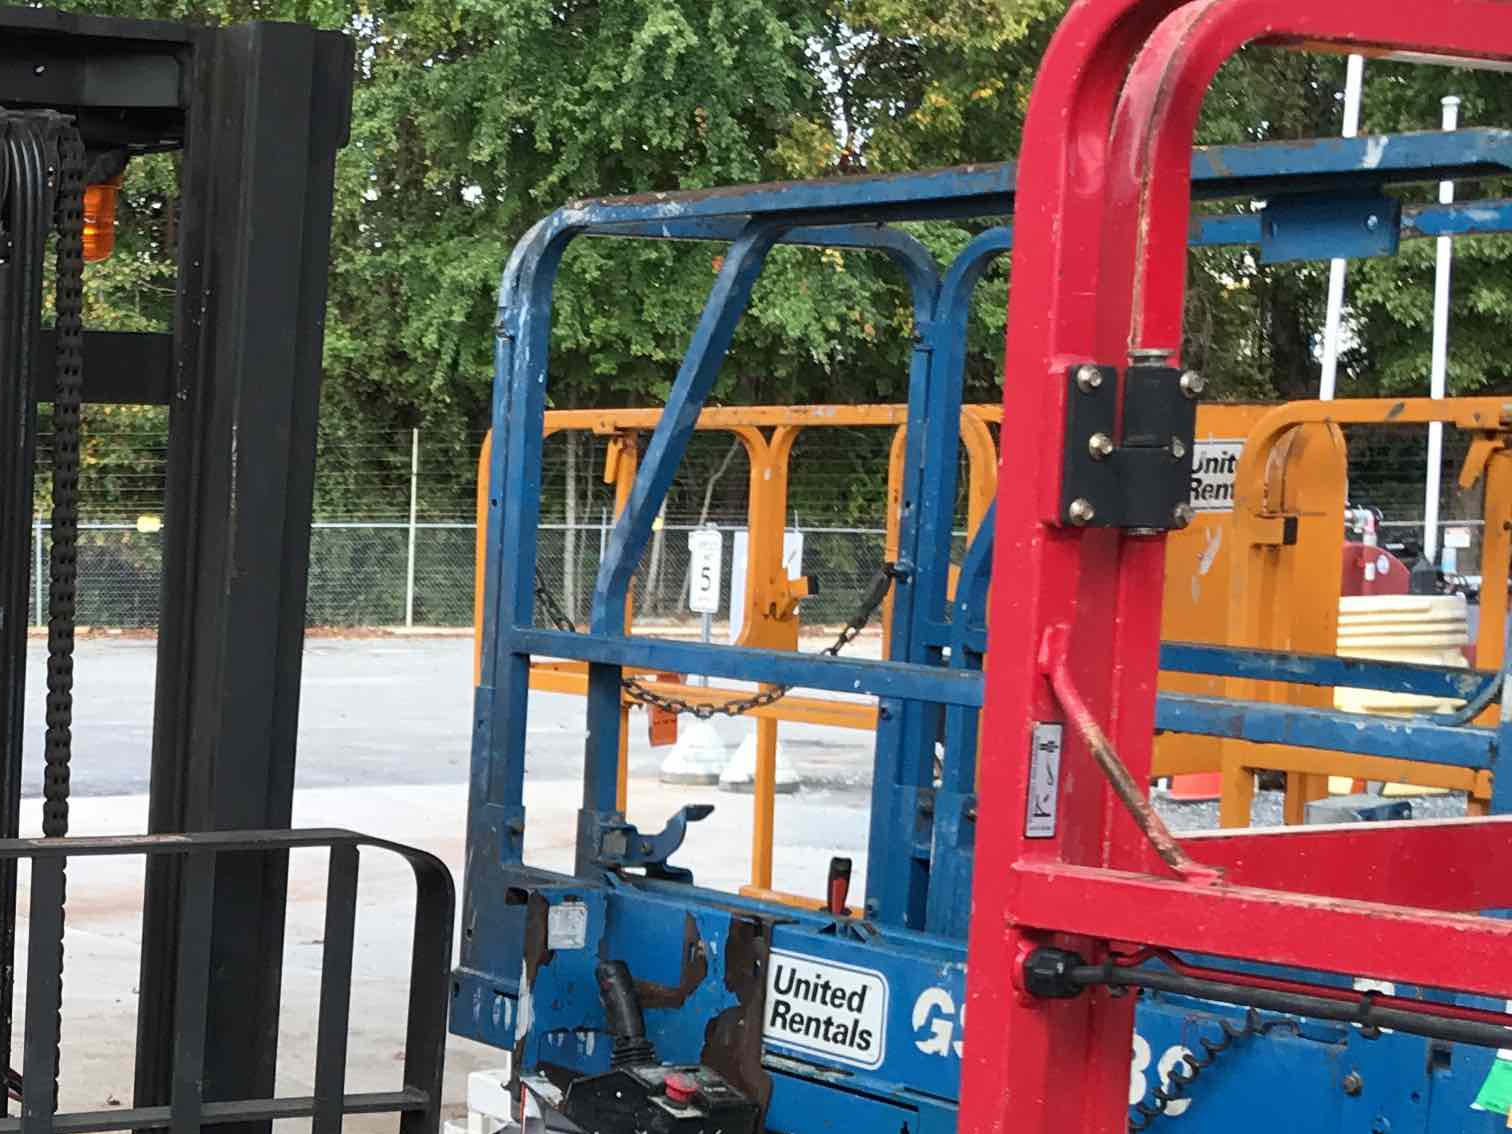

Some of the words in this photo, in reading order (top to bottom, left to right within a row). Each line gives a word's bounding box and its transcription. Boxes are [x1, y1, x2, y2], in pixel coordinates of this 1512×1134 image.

[701, 567, 711, 591] 5
[773, 965, 869, 1014] United
[769, 1000, 874, 1051] Rentals
